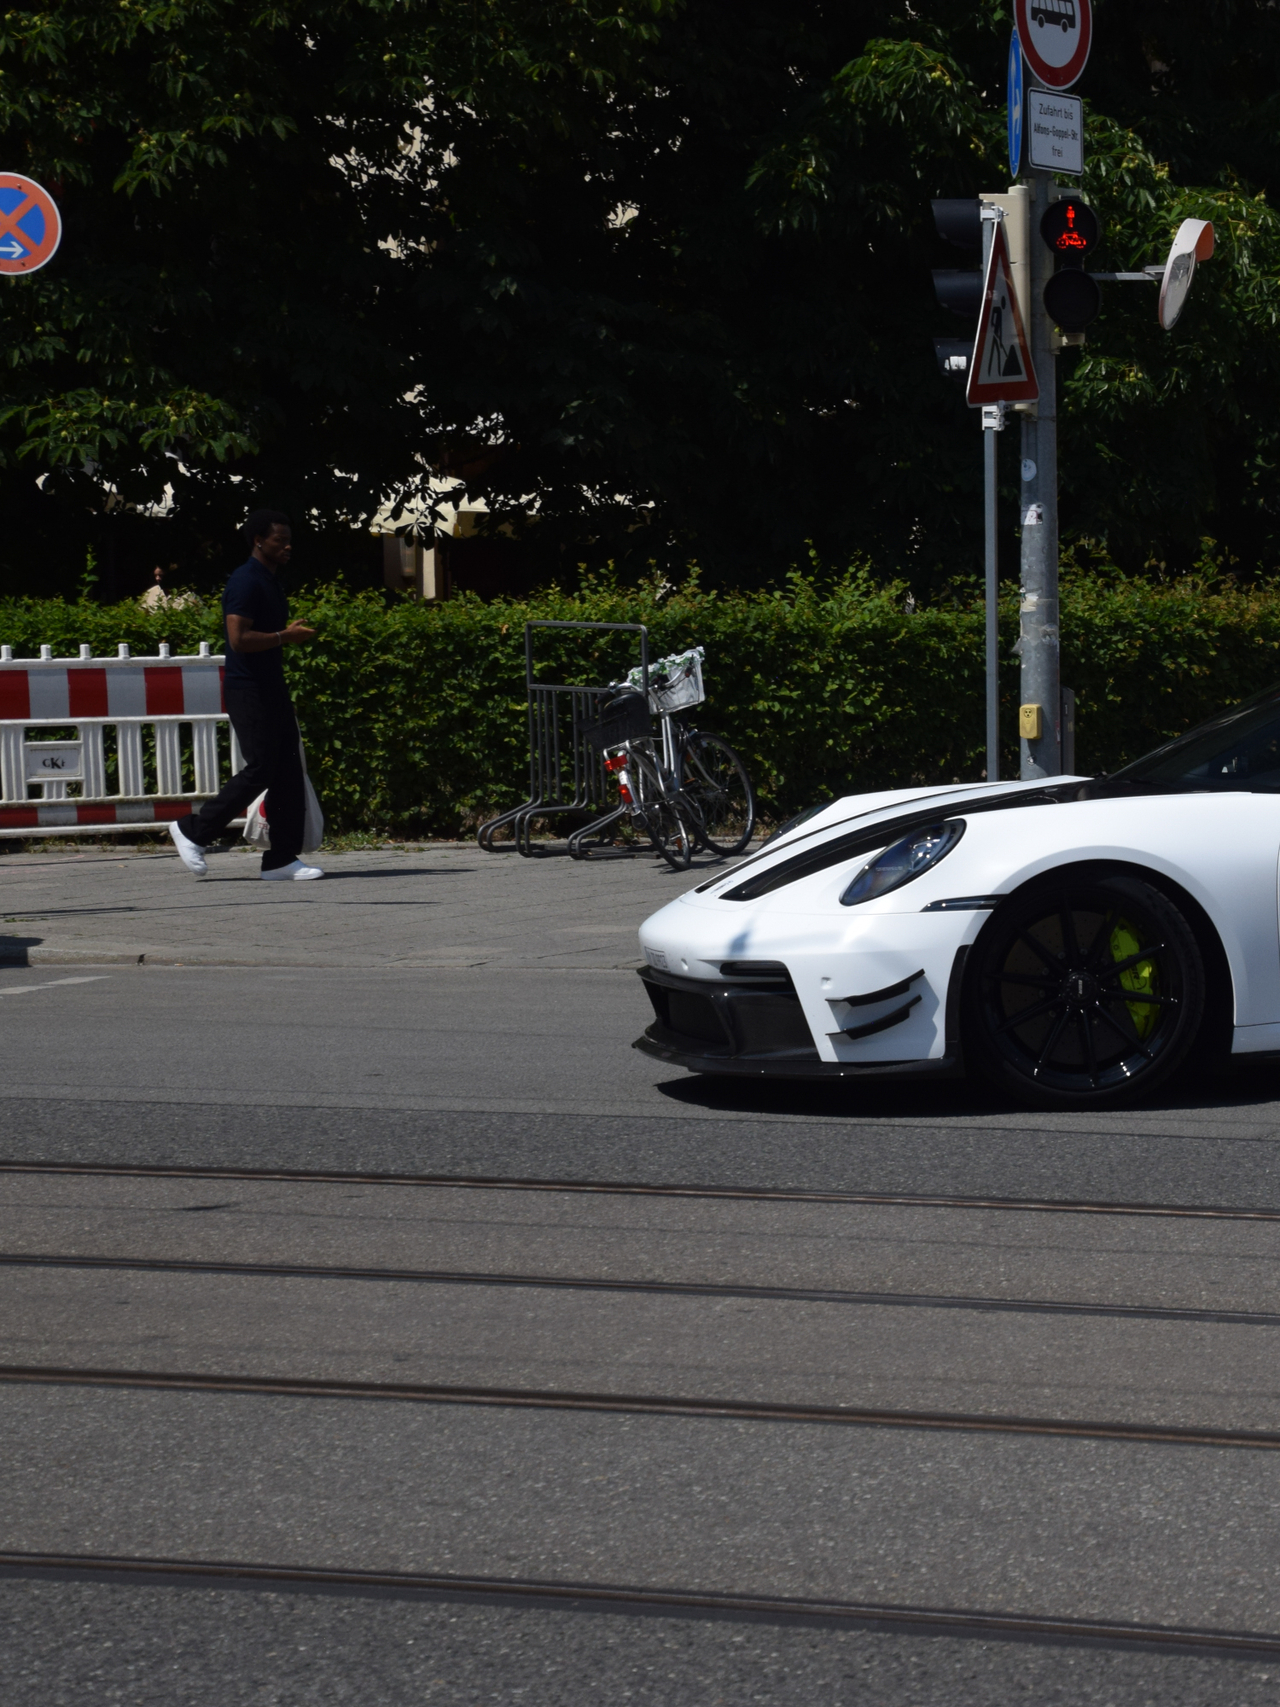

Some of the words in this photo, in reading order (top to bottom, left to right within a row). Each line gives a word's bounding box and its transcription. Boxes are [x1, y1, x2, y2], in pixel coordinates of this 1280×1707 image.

[1038, 103, 1063, 118] Zufahrt
[1064, 108, 1074, 120] bis
[1051, 145, 1063, 157] frei
